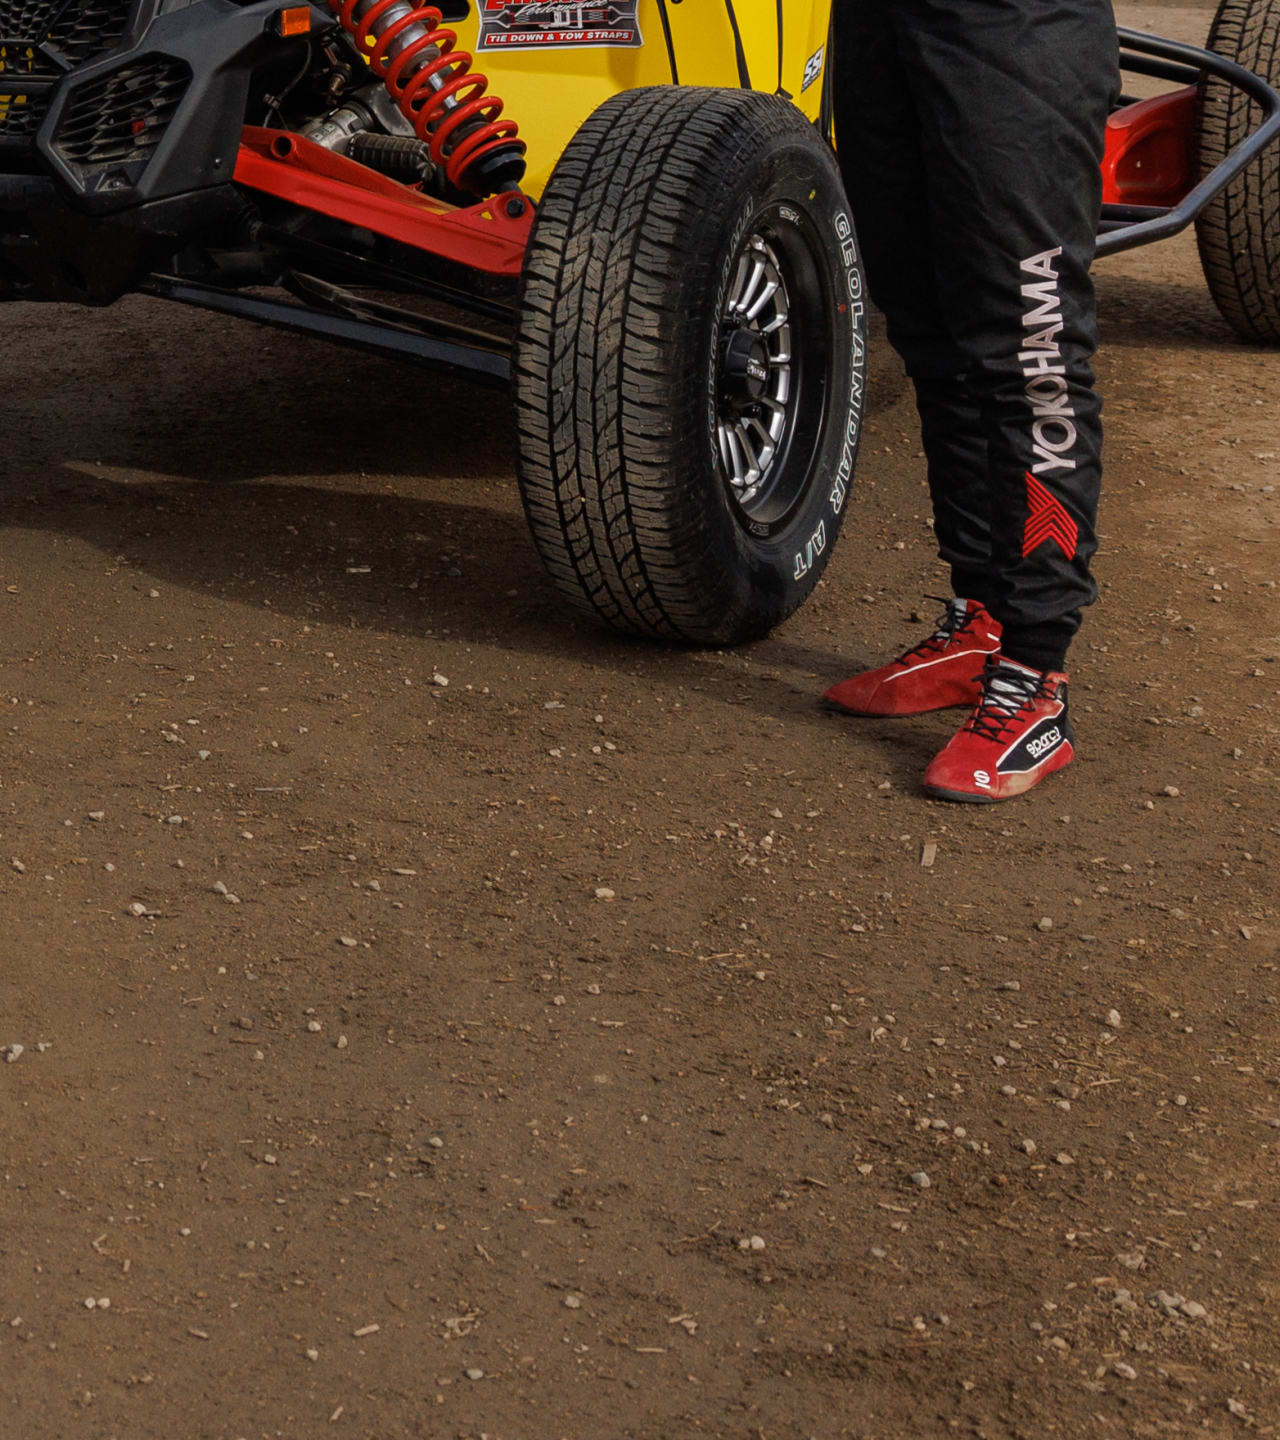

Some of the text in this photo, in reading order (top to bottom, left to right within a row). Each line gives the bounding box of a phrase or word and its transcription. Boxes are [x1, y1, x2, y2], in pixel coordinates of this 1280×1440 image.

[490, 30, 629, 43] TIE DOWN & TOW STRAPS
[793, 212, 865, 581] GEOLANDAR A/T
[1018, 245, 1077, 474] YOKOHAMA
